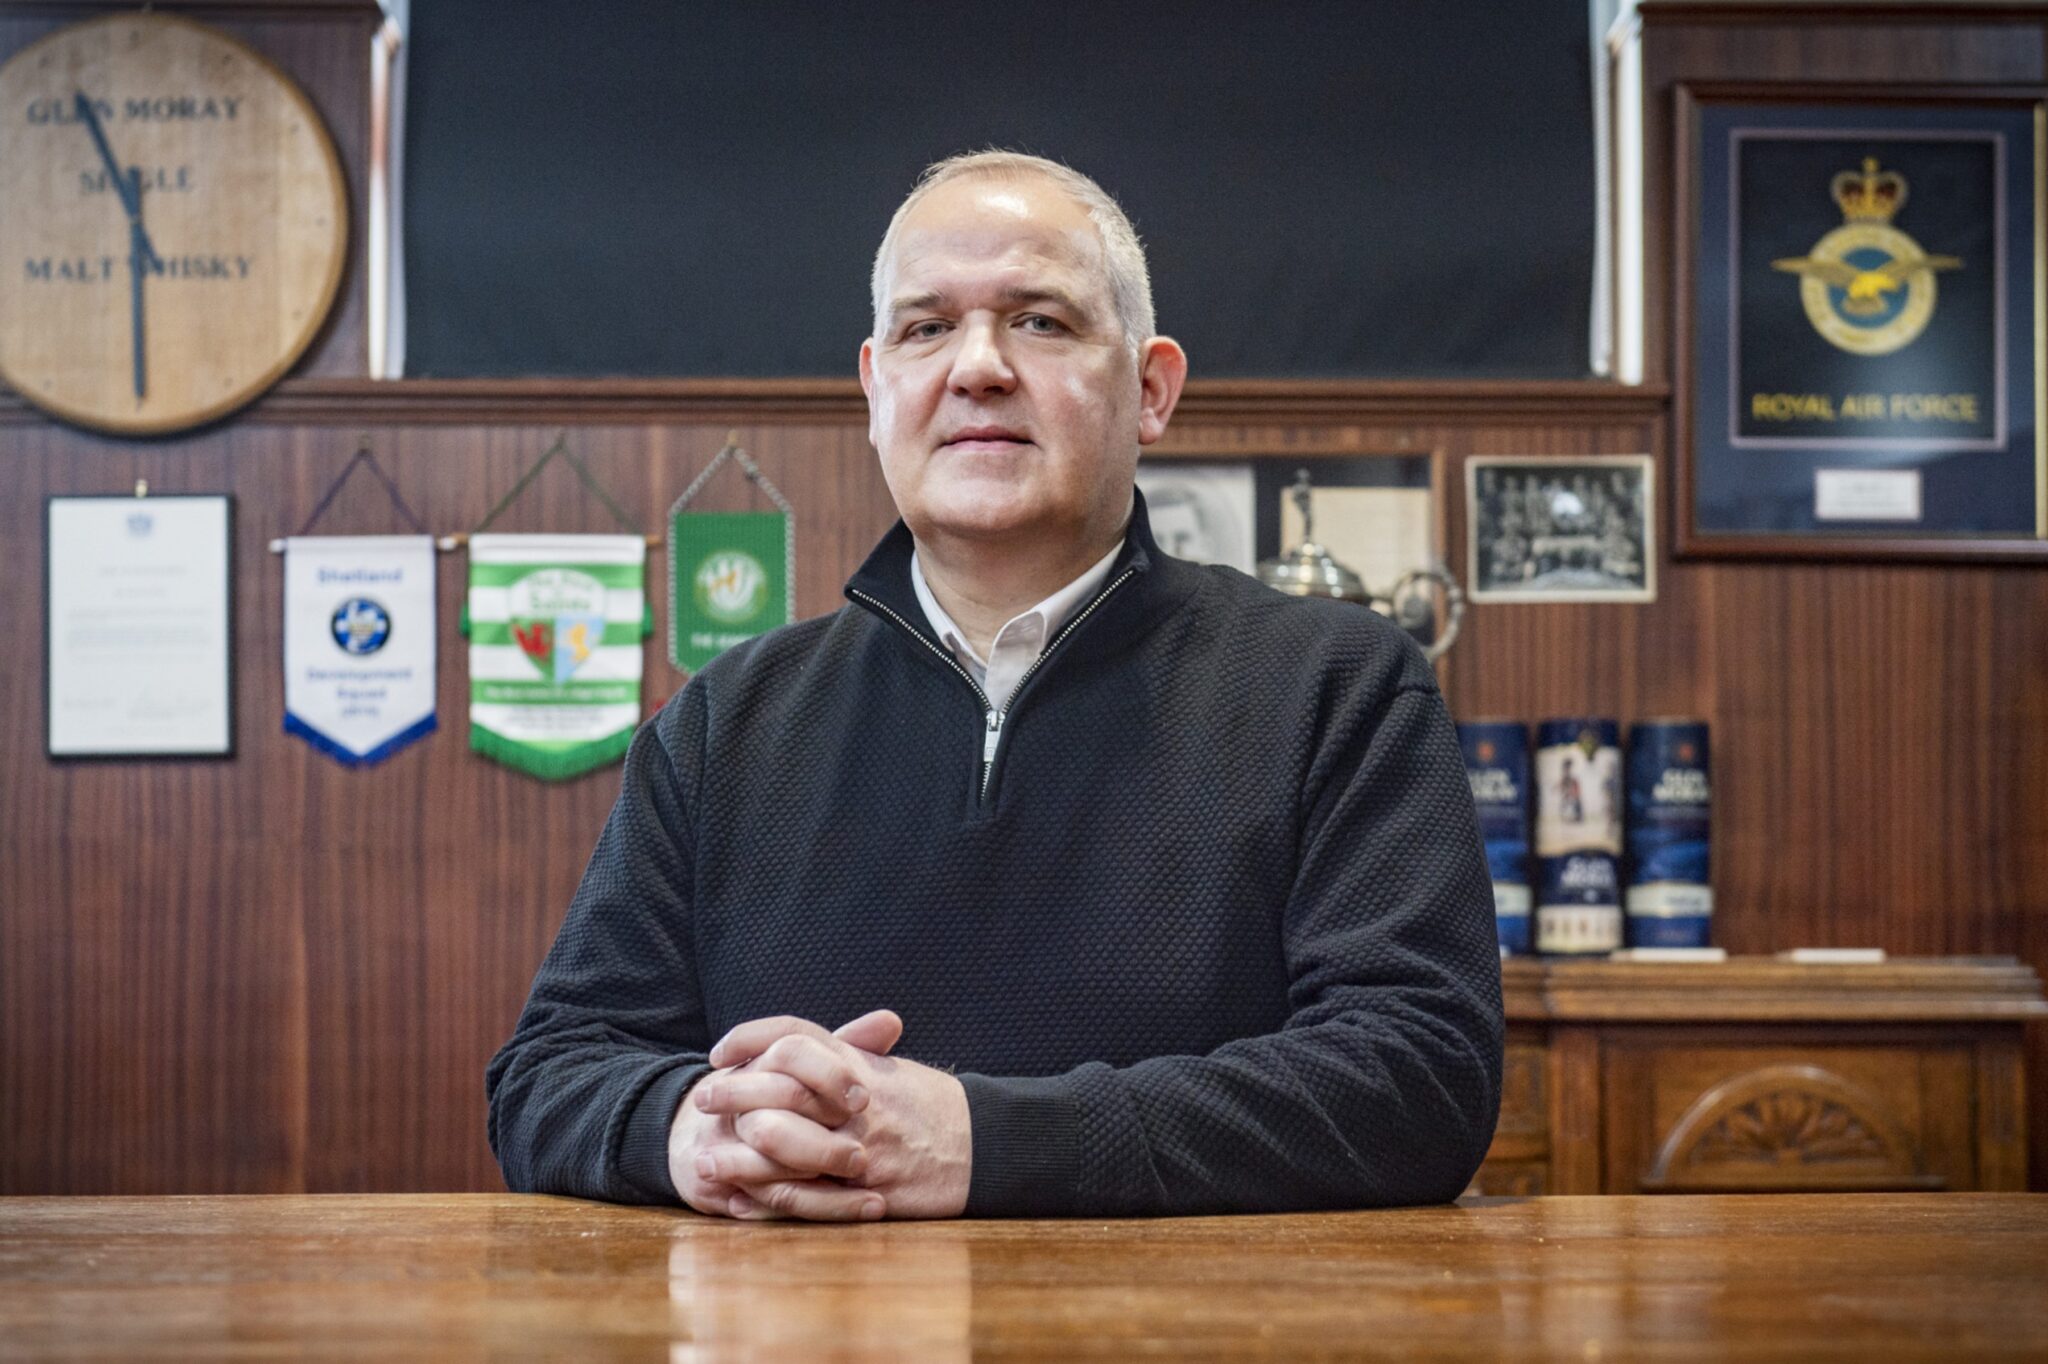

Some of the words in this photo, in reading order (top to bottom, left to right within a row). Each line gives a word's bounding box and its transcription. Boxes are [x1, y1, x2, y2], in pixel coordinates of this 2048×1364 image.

[26, 96, 113, 125] GLN
[126, 95, 242, 120] MORAY
[79, 166, 194, 196] SILE
[24, 256, 114, 283] MALT
[1752, 393, 1835, 422] ROYAL
[1840, 394, 1887, 420] AIR
[1890, 394, 1978, 422] FORCE
